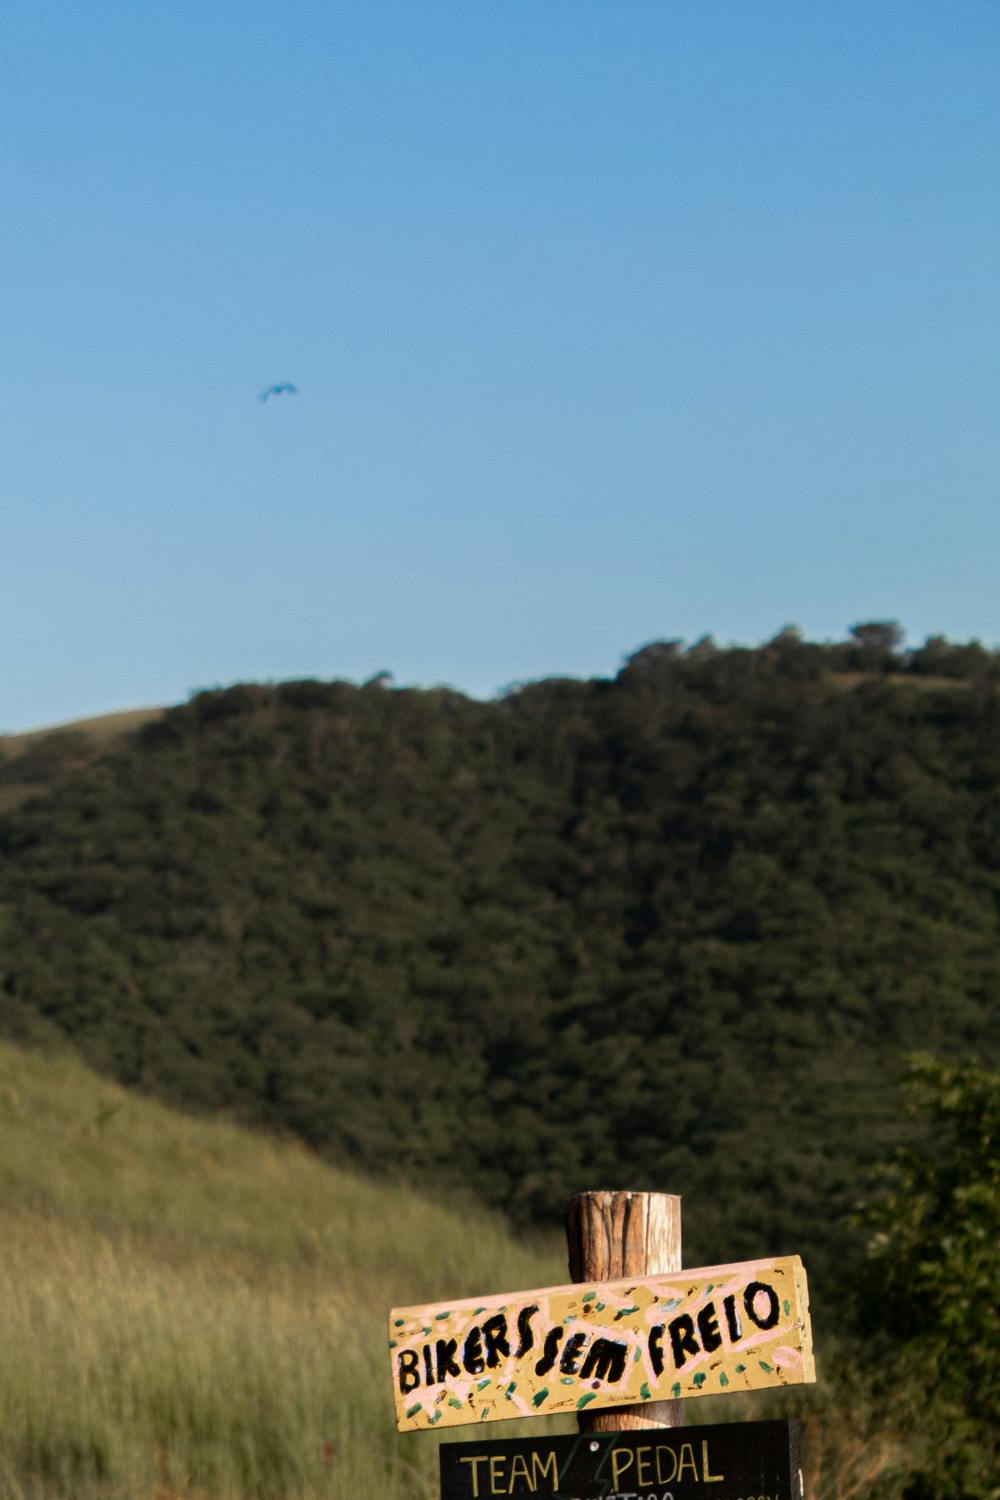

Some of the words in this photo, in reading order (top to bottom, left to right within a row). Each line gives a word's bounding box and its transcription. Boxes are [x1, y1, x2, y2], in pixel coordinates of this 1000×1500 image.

[398, 1304, 539, 1394] BIKERS
[534, 1326, 628, 1383] SEM
[648, 1280, 780, 1377] FREIO
[460, 1451, 559, 1497] TEAM
[611, 1440, 725, 1491] PEDAL
